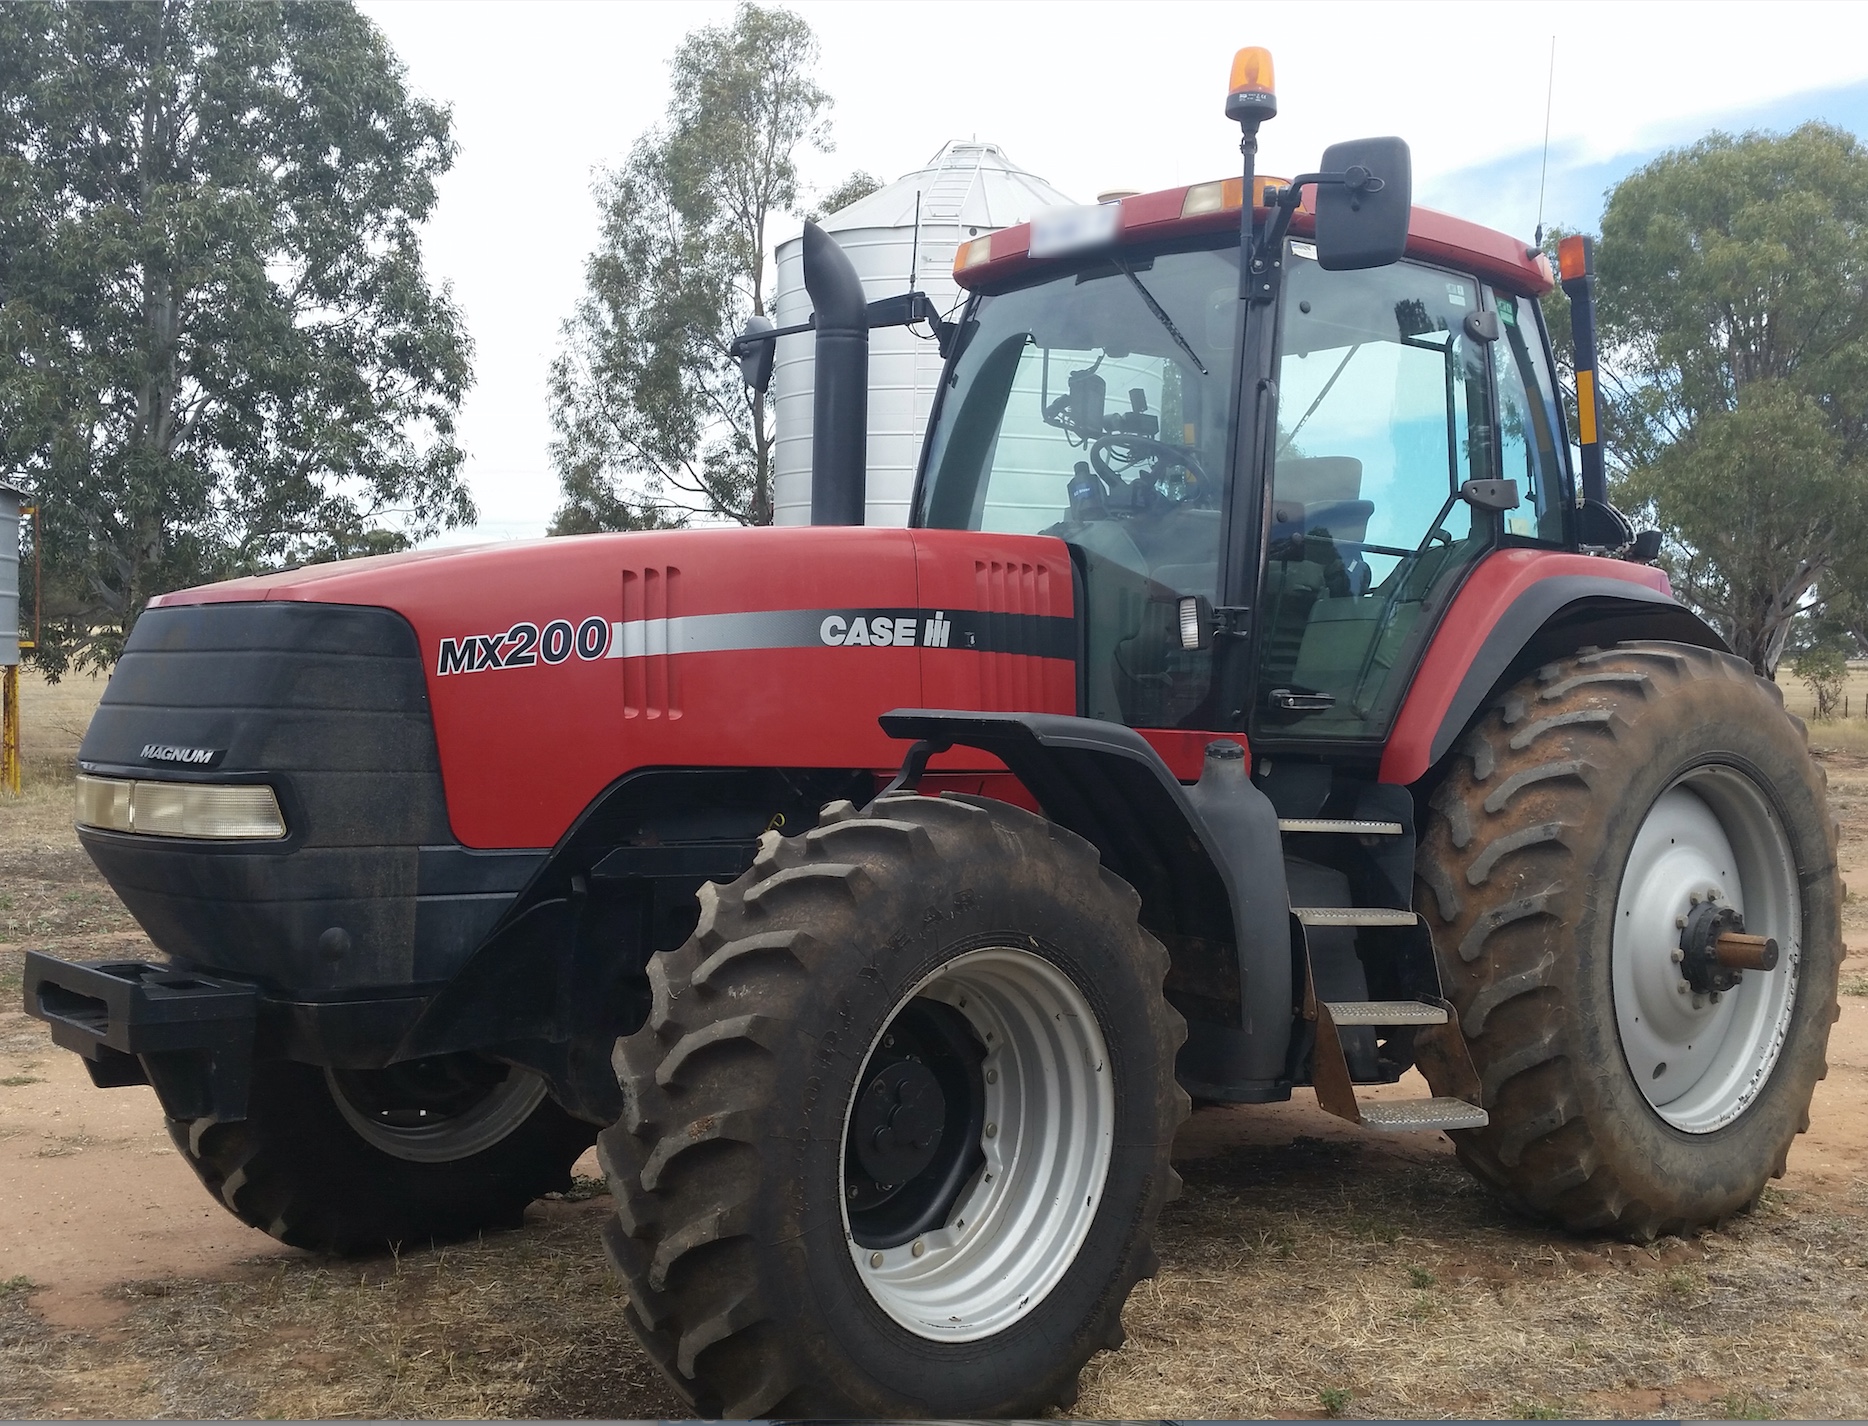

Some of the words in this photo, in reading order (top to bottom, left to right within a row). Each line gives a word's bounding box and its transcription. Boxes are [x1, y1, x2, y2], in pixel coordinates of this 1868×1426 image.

[436, 616, 609, 676] MX200
[820, 615, 917, 647] CASE
[140, 744, 214, 764] MAGNUM
